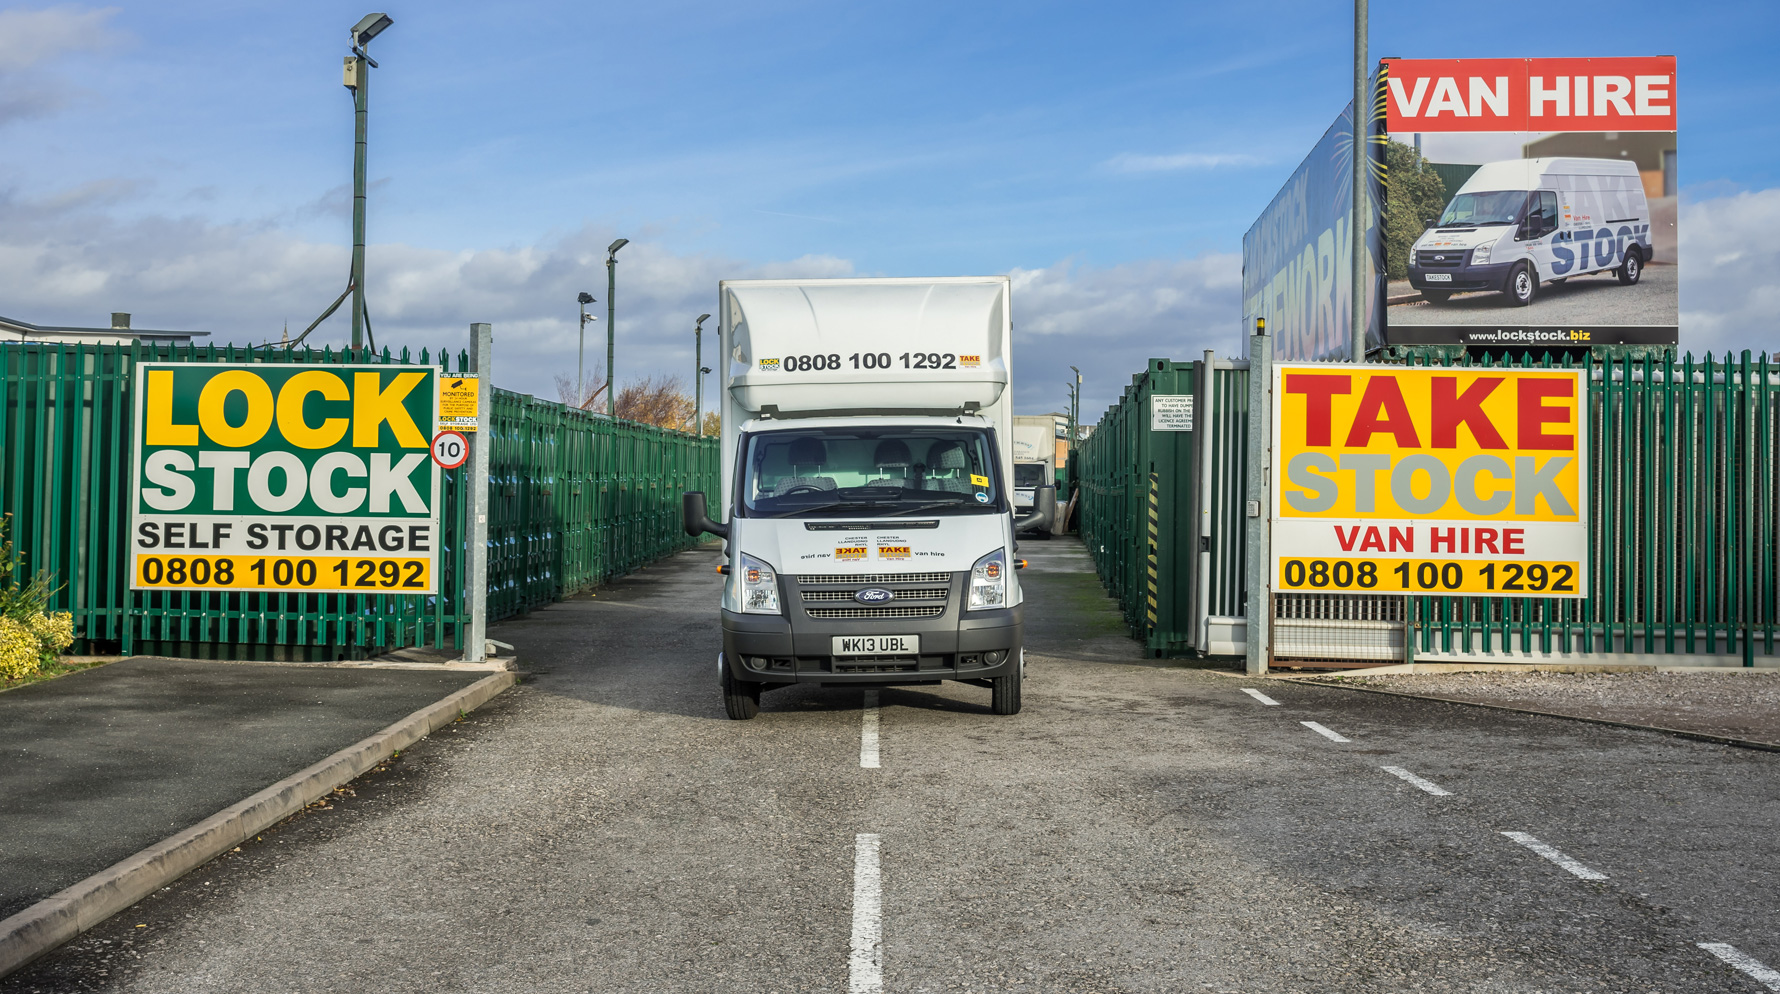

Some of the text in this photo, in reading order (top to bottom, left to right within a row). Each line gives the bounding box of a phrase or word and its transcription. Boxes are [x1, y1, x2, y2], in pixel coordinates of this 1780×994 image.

[1387, 74, 1671, 118] VAN HIRE
[1550, 224, 1650, 276] STOCK
[1469, 329, 1591, 341] www.lockstock.biz
[783, 352, 957, 372] 0808 100 1292
[145, 369, 431, 449] LOCK
[1285, 373, 1575, 451] TAKE
[438, 441, 460, 458] 10
[141, 449, 431, 514] STOCK
[1284, 451, 1577, 517] STOCK
[137, 521, 431, 552] SELF STORAGE
[1333, 525, 1526, 555] VAN HIRE
[142, 557, 426, 588] 0808 100 1292
[1284, 559, 1574, 592] 0808 100 1292
[863, 591, 885, 600] Ford
[841, 637, 909, 652] WK13 UBL
